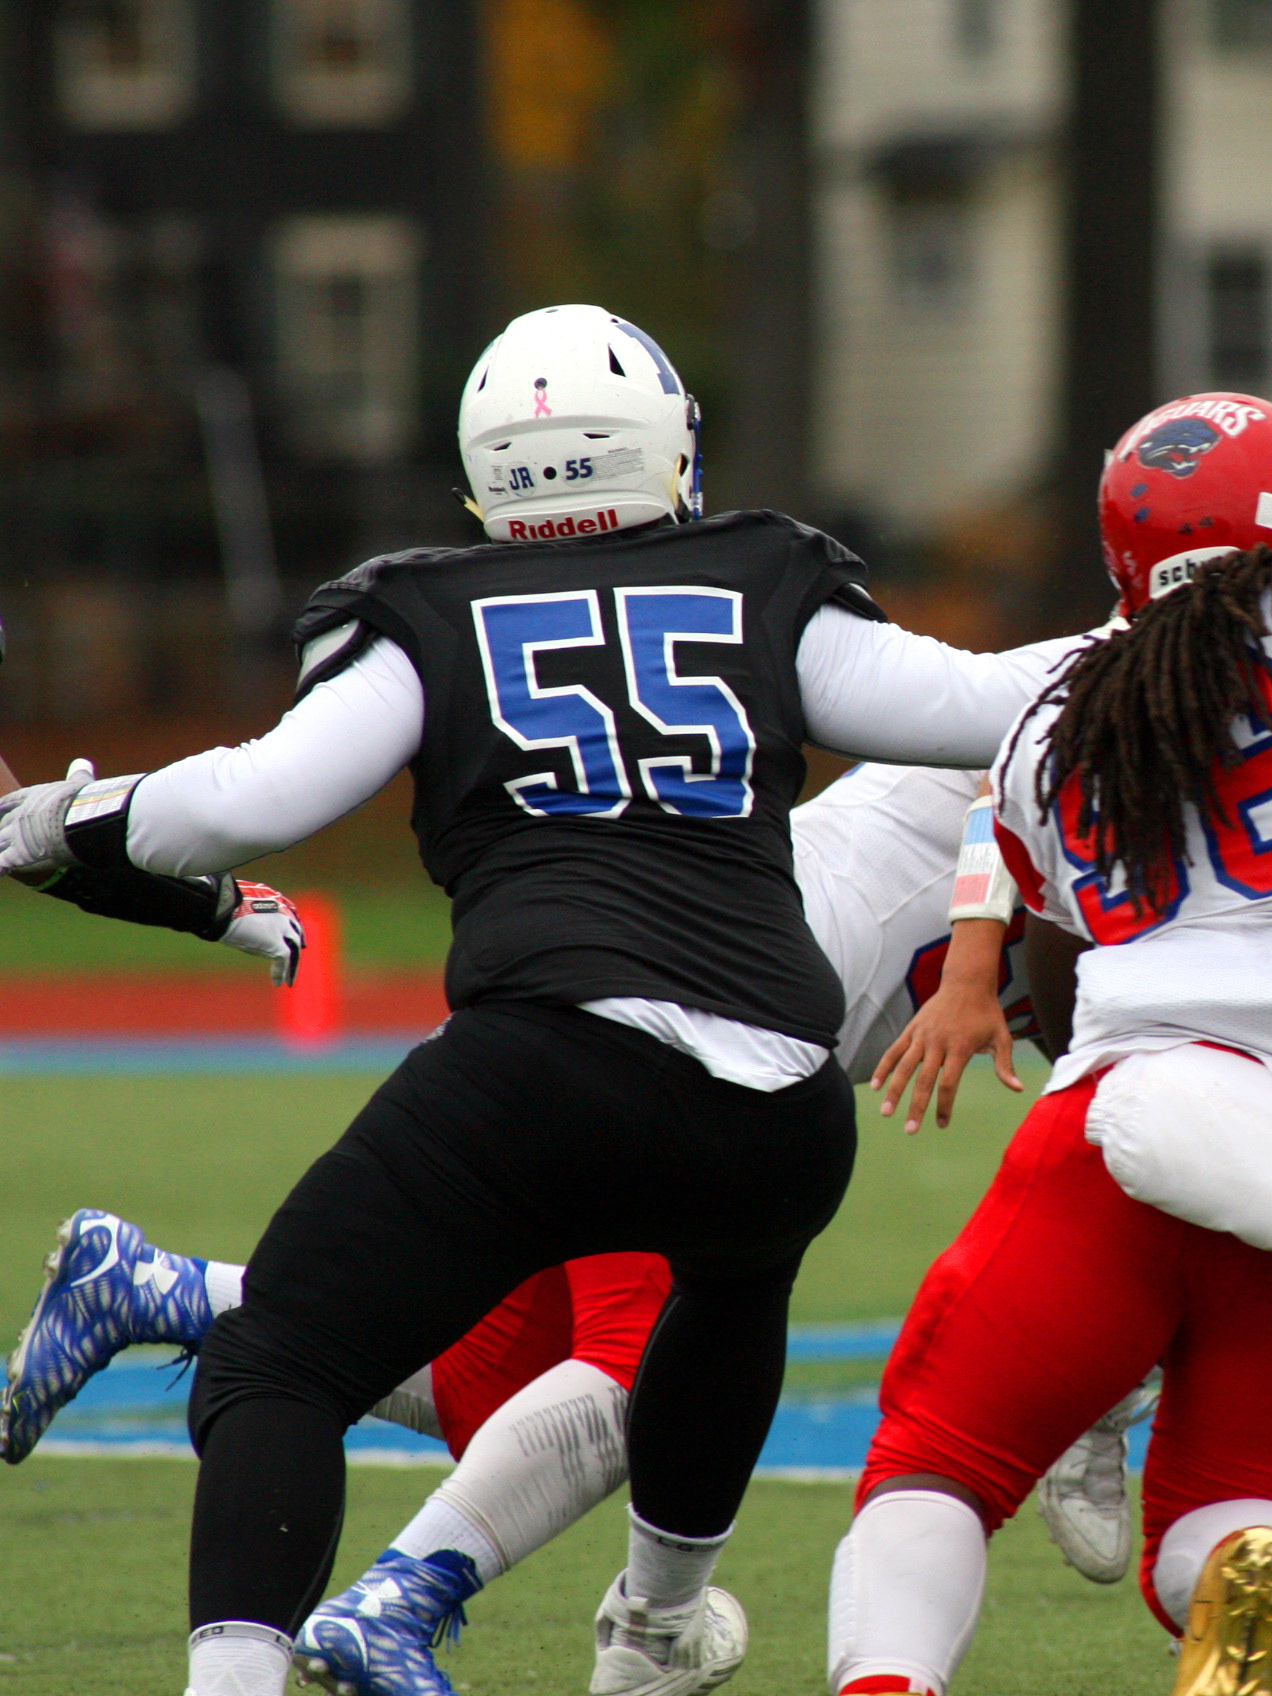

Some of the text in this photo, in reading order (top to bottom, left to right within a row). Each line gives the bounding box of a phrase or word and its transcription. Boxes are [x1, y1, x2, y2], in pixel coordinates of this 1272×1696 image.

[509, 466, 535, 491] JR
[565, 457, 593, 481] 55
[508, 508, 619, 540] Riddell
[1159, 559, 1196, 586] sch
[470, 585, 757, 819] 55
